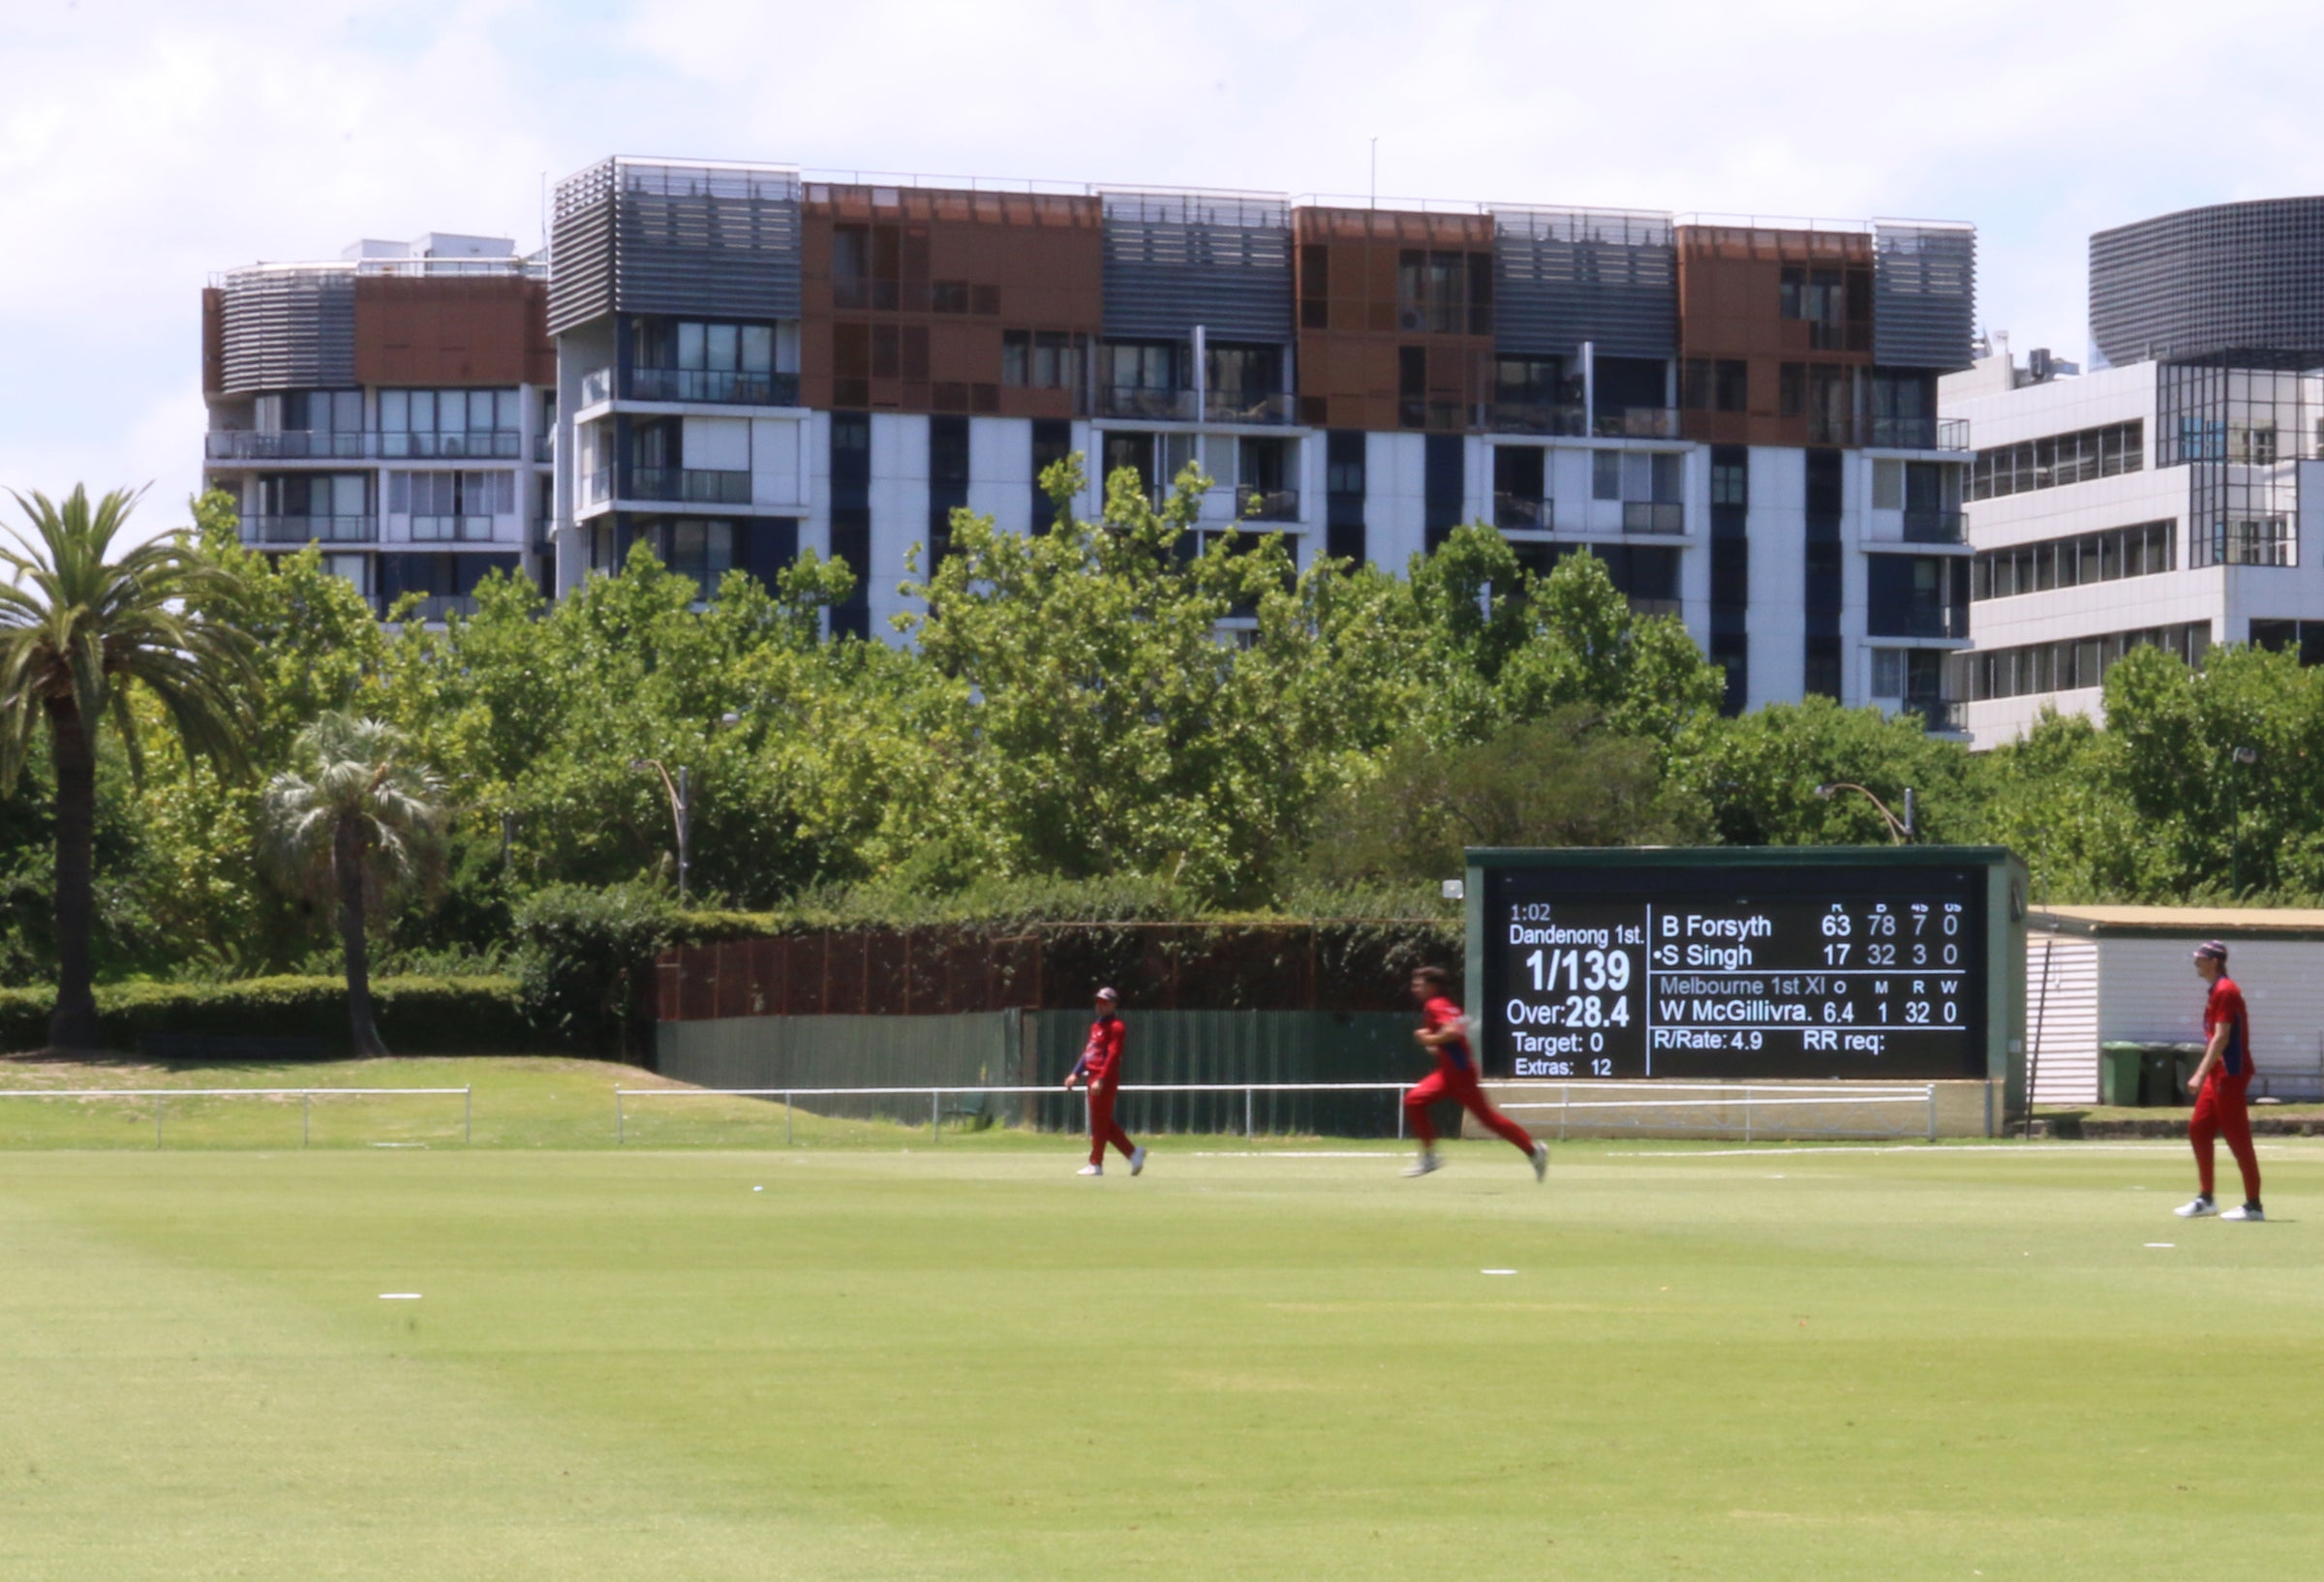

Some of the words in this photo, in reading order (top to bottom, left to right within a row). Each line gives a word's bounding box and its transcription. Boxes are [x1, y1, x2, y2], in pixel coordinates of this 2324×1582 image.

[1511, 903, 1551, 921] 1:02
[1510, 924, 1608, 949] Dandenong
[1614, 924, 1644, 944] 1st.
[1662, 915, 1680, 936] B
[1687, 915, 1771, 942] Forsyth
[1821, 915, 1851, 936] 63
[1867, 915, 1896, 936] 78
[1912, 915, 1927, 935] 7
[1943, 915, 1958, 936] 0
[1662, 944, 1679, 965] S
[1687, 944, 1752, 970] Singh
[1822, 944, 1851, 965] 17
[1867, 944, 1895, 965] 32
[1912, 944, 1927, 964] 3
[1943, 944, 1958, 964] 0
[1525, 949, 1630, 991] 1/139
[1660, 976, 1763, 995] Melbourne
[1771, 976, 1799, 995] 1st
[1805, 976, 1825, 994] XI
[1833, 981, 1847, 994] O
[1875, 981, 1888, 994] M
[1912, 981, 1925, 994] R
[1941, 981, 1958, 994] W
[1660, 1000, 1686, 1021] W
[1692, 1000, 1813, 1021] McGillivra.
[1823, 1001, 1854, 1022] 6.4
[1878, 1001, 1887, 1022] 1
[1905, 1001, 1930, 1023] 32
[1943, 1001, 1957, 1022] 0
[1512, 1031, 1583, 1056] Target:
[1589, 1032, 1604, 1052] 0
[1654, 1029, 1728, 1049] R/Rate:
[1730, 1031, 1762, 1050] 4.9
[1803, 1029, 1838, 1050] RR
[1845, 1034, 1885, 1055] req:
[1514, 1057, 1575, 1076] Extras:
[1591, 1058, 1611, 1076] 12
